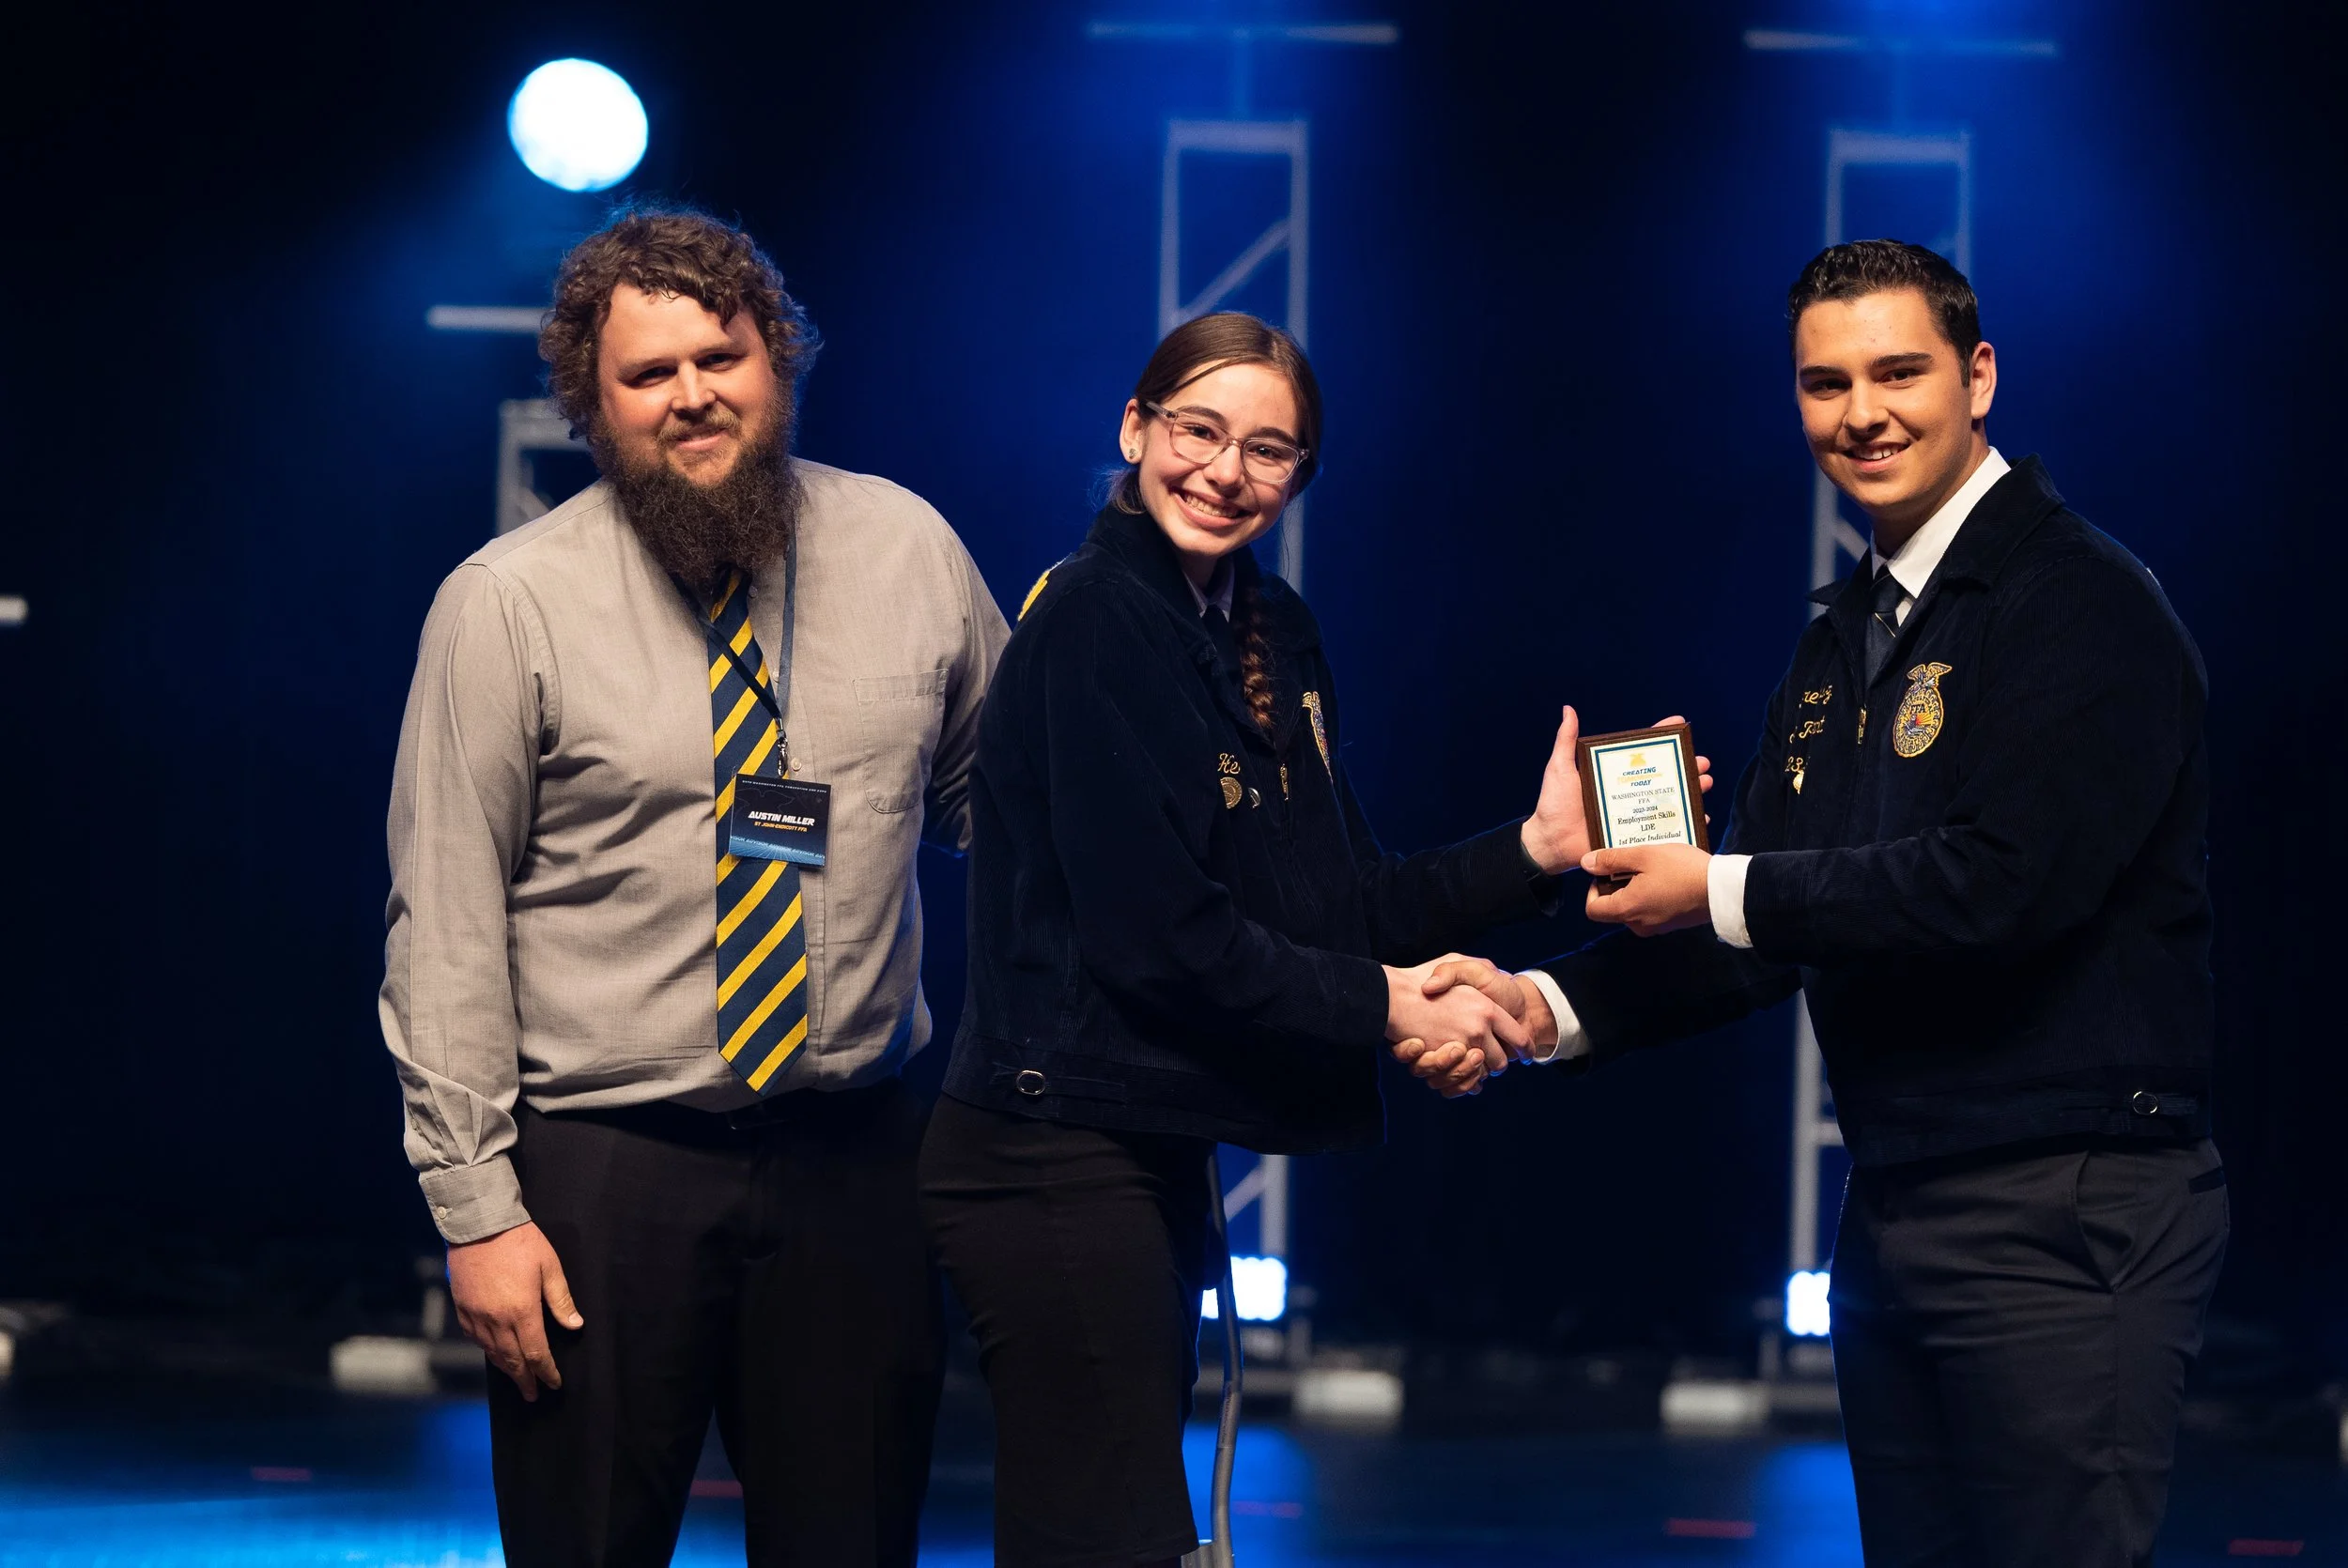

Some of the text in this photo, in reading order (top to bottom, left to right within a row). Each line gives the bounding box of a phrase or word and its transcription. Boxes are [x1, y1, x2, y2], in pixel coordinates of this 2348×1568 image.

[1623, 766, 1657, 776] CREATING
[1612, 791, 1654, 800] WASHINGTON
[749, 811, 814, 825] AUSTIN MILLER
[1617, 814, 1657, 825] Employment
[1629, 836, 1646, 844] Place
[1647, 831, 1681, 840] Individual
